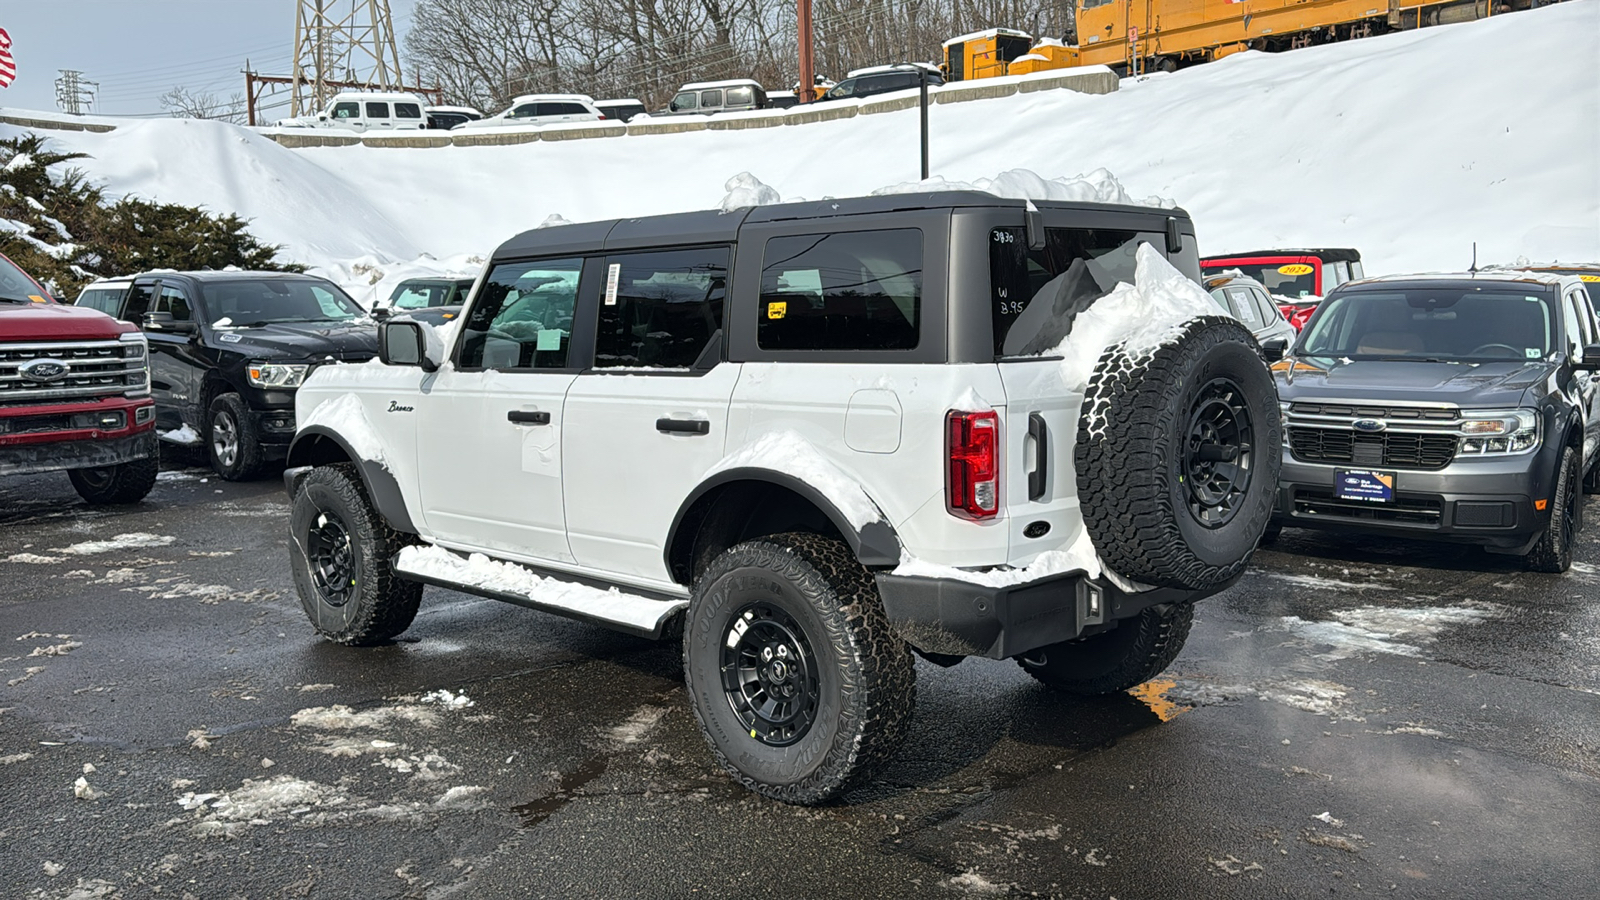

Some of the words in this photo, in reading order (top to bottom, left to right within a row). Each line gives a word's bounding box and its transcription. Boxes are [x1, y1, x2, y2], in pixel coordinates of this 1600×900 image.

[998, 287, 1008, 298] W
[34, 364, 59, 376] Ford
[387, 400, 414, 412] Bronco
[697, 574, 784, 648] GOODYEAR
